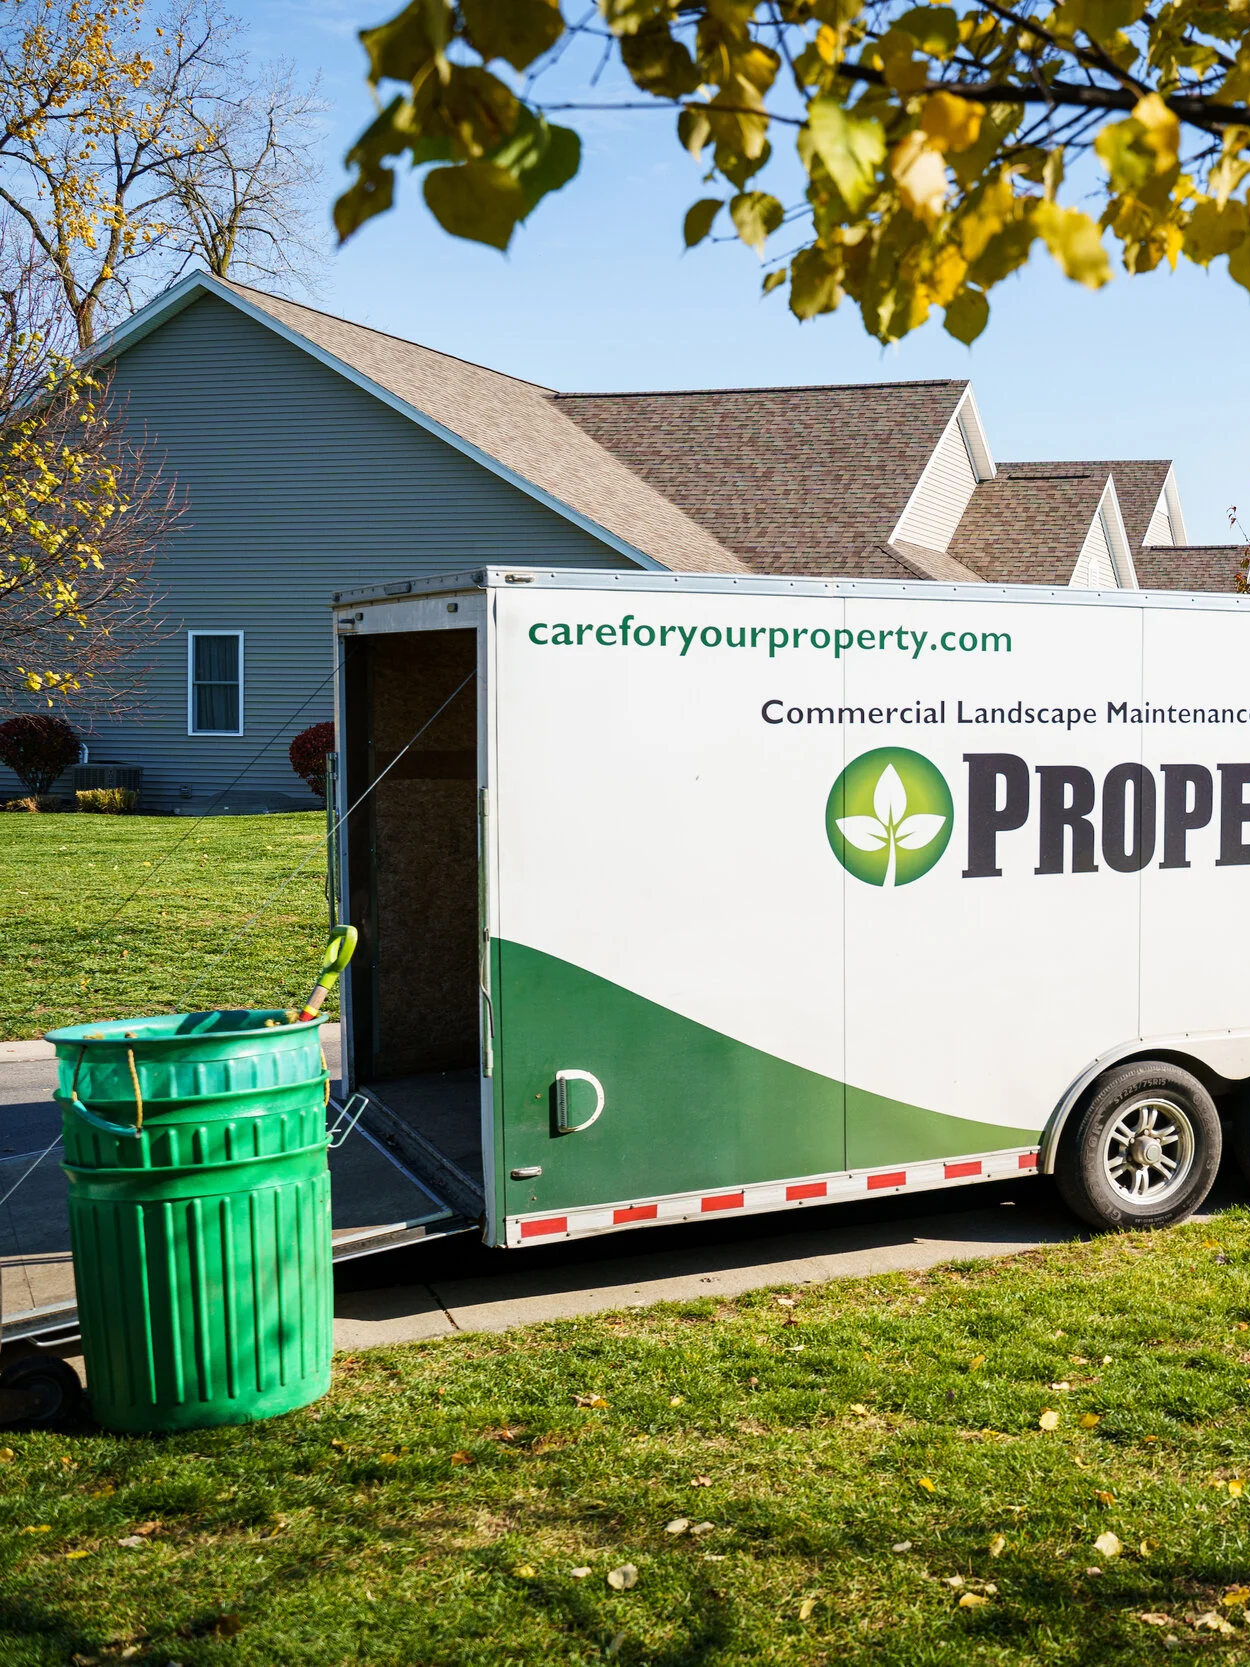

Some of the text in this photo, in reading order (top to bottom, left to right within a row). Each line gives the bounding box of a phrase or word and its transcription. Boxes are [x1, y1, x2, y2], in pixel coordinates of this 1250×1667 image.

[528, 615, 1013, 660] careforyourproperty.com
[761, 699, 946, 726] Commercial
[957, 700, 1098, 731] Landscape
